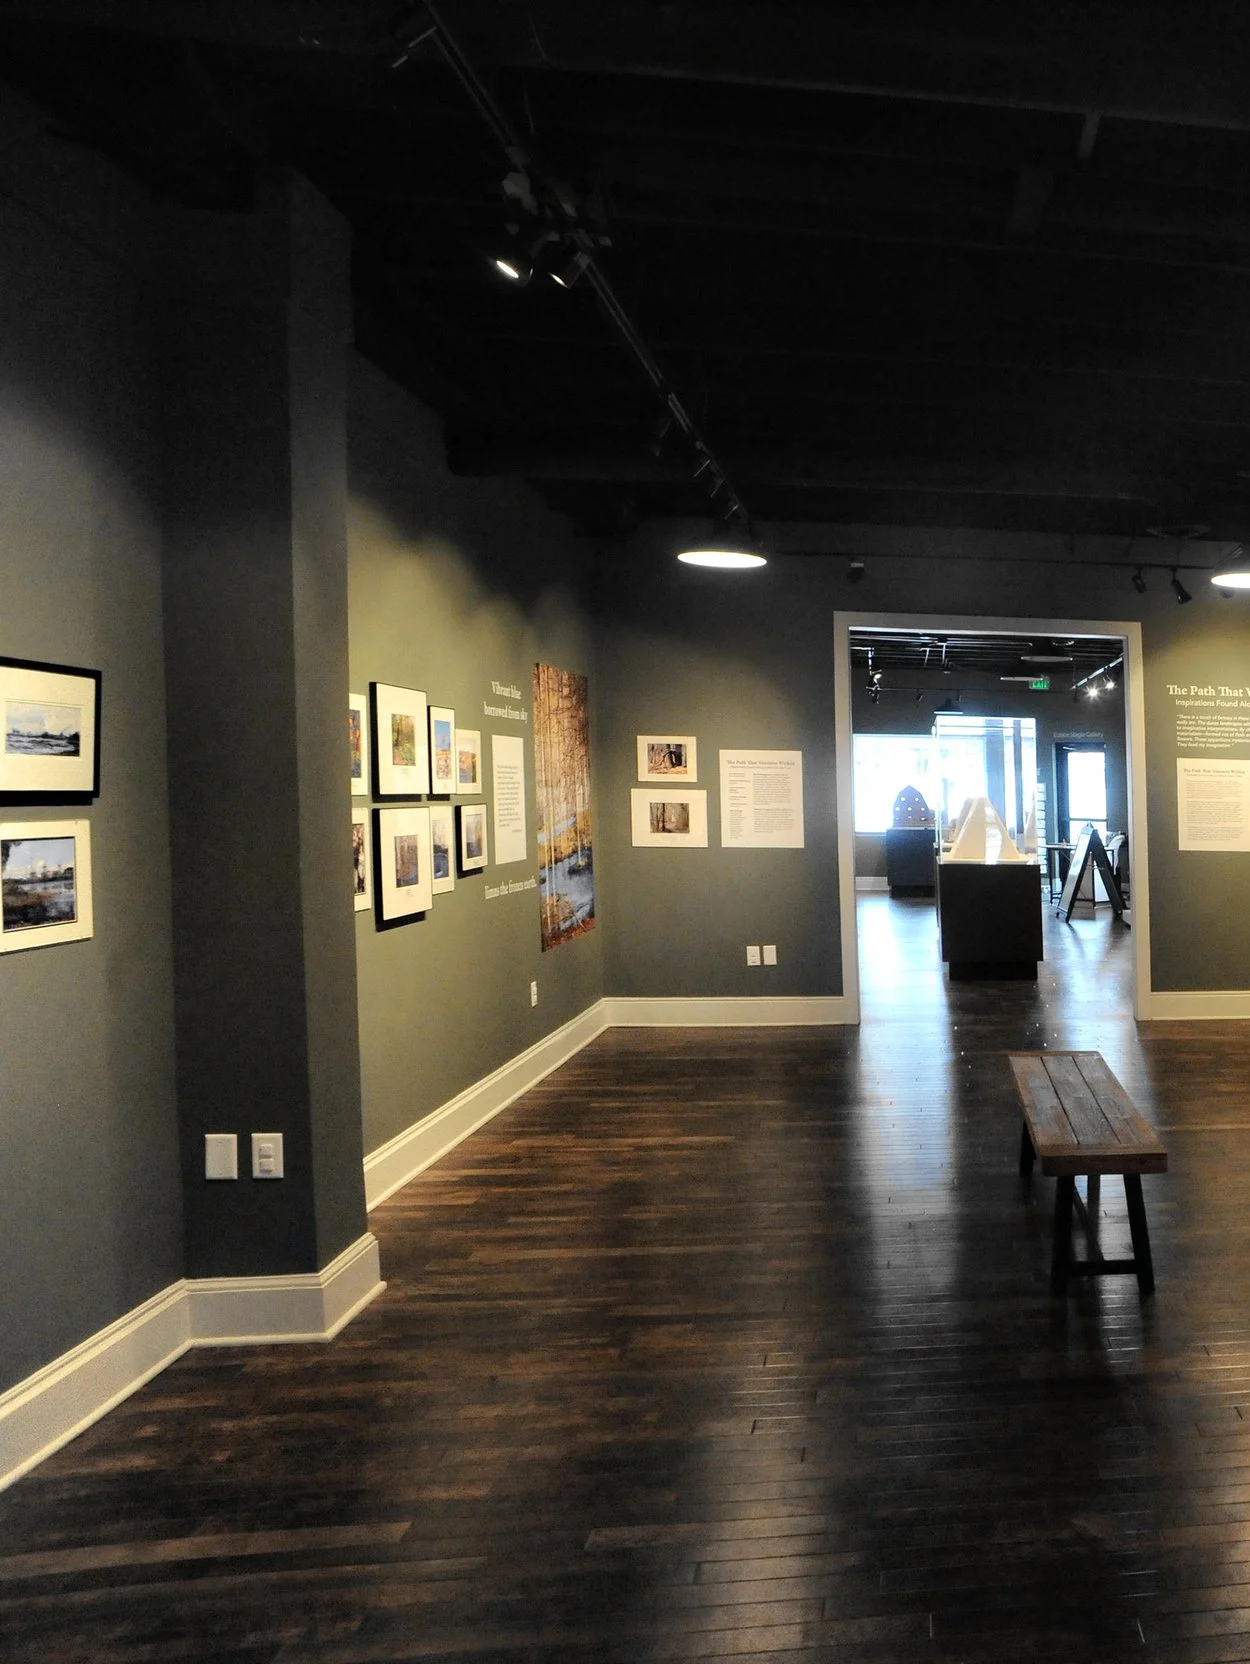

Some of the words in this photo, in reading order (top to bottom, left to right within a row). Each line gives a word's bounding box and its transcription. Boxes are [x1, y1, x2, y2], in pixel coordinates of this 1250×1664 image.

[1166, 685, 1188, 696] The
[1190, 685, 1216, 697] Path
[1218, 686, 1243, 697] That
[1176, 699, 1215, 708] Inspirations
[1216, 700, 1239, 708] Found
